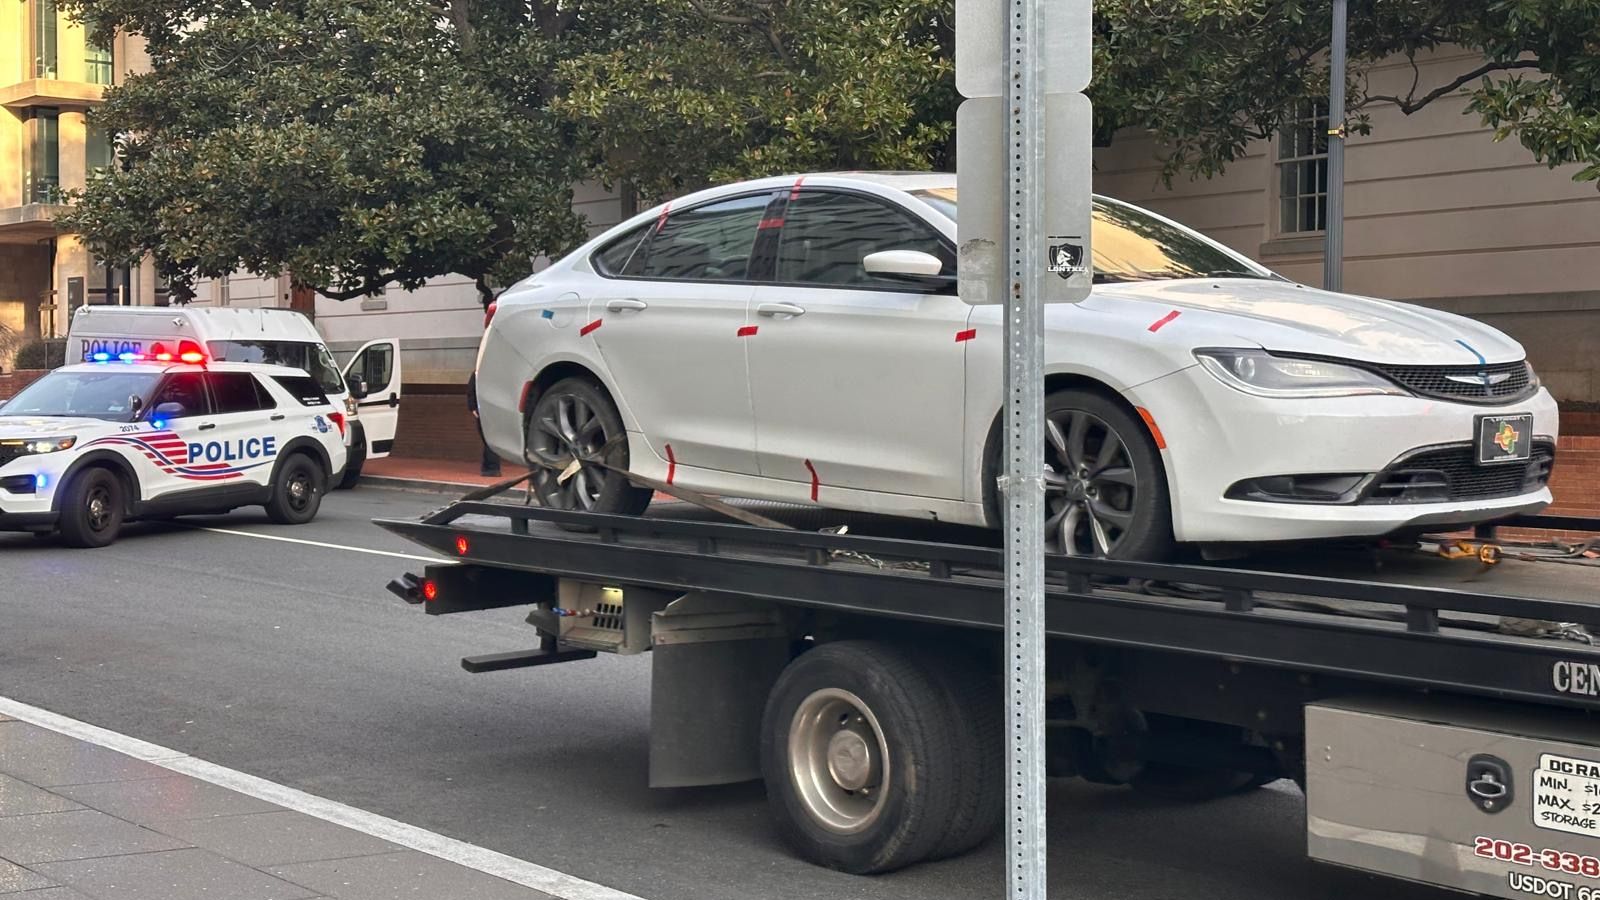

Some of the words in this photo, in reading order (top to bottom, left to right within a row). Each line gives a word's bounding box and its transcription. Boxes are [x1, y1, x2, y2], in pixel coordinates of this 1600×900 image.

[80, 339, 142, 361] POLICE
[119, 424, 140, 433] 2074
[188, 436, 277, 464] POLICE
[1549, 759, 1573, 773] DC
[1540, 776, 1572, 792] MIN.
[1584, 781, 1600, 797] $1
[1541, 811, 1597, 829] STORAGE
[1475, 837, 1600, 877] 202-338
[1509, 872, 1573, 900] USDOT
